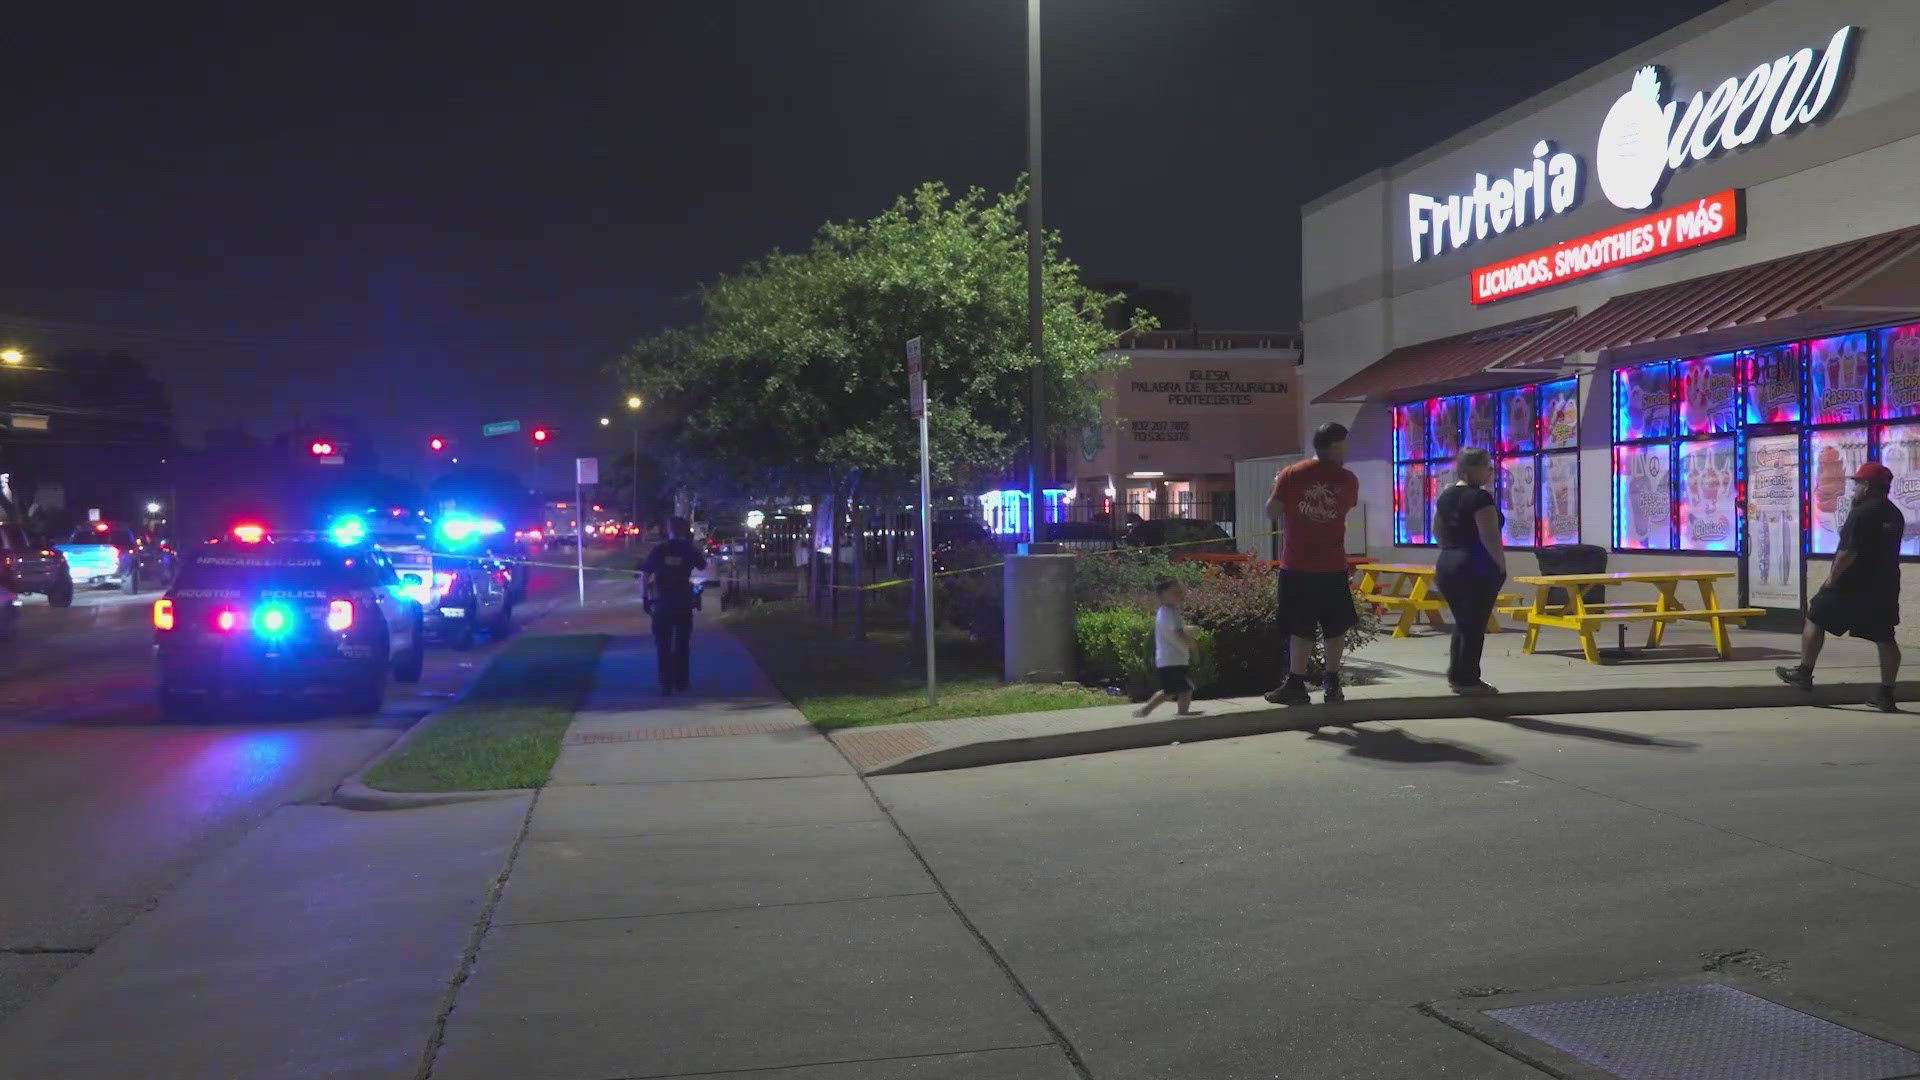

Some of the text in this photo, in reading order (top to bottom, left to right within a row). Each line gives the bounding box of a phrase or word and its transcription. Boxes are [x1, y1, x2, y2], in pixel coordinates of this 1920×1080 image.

[1409, 140, 1577, 263] Fruteria
[1479, 199, 1723, 298] LICUADOS, SMOOTHIES Y MÁS
[1131, 381, 1182, 393] PALABRA
[1186, 381, 1200, 393] DE
[1823, 389, 1863, 408] Raspas
[261, 590, 327, 599] POLICE
